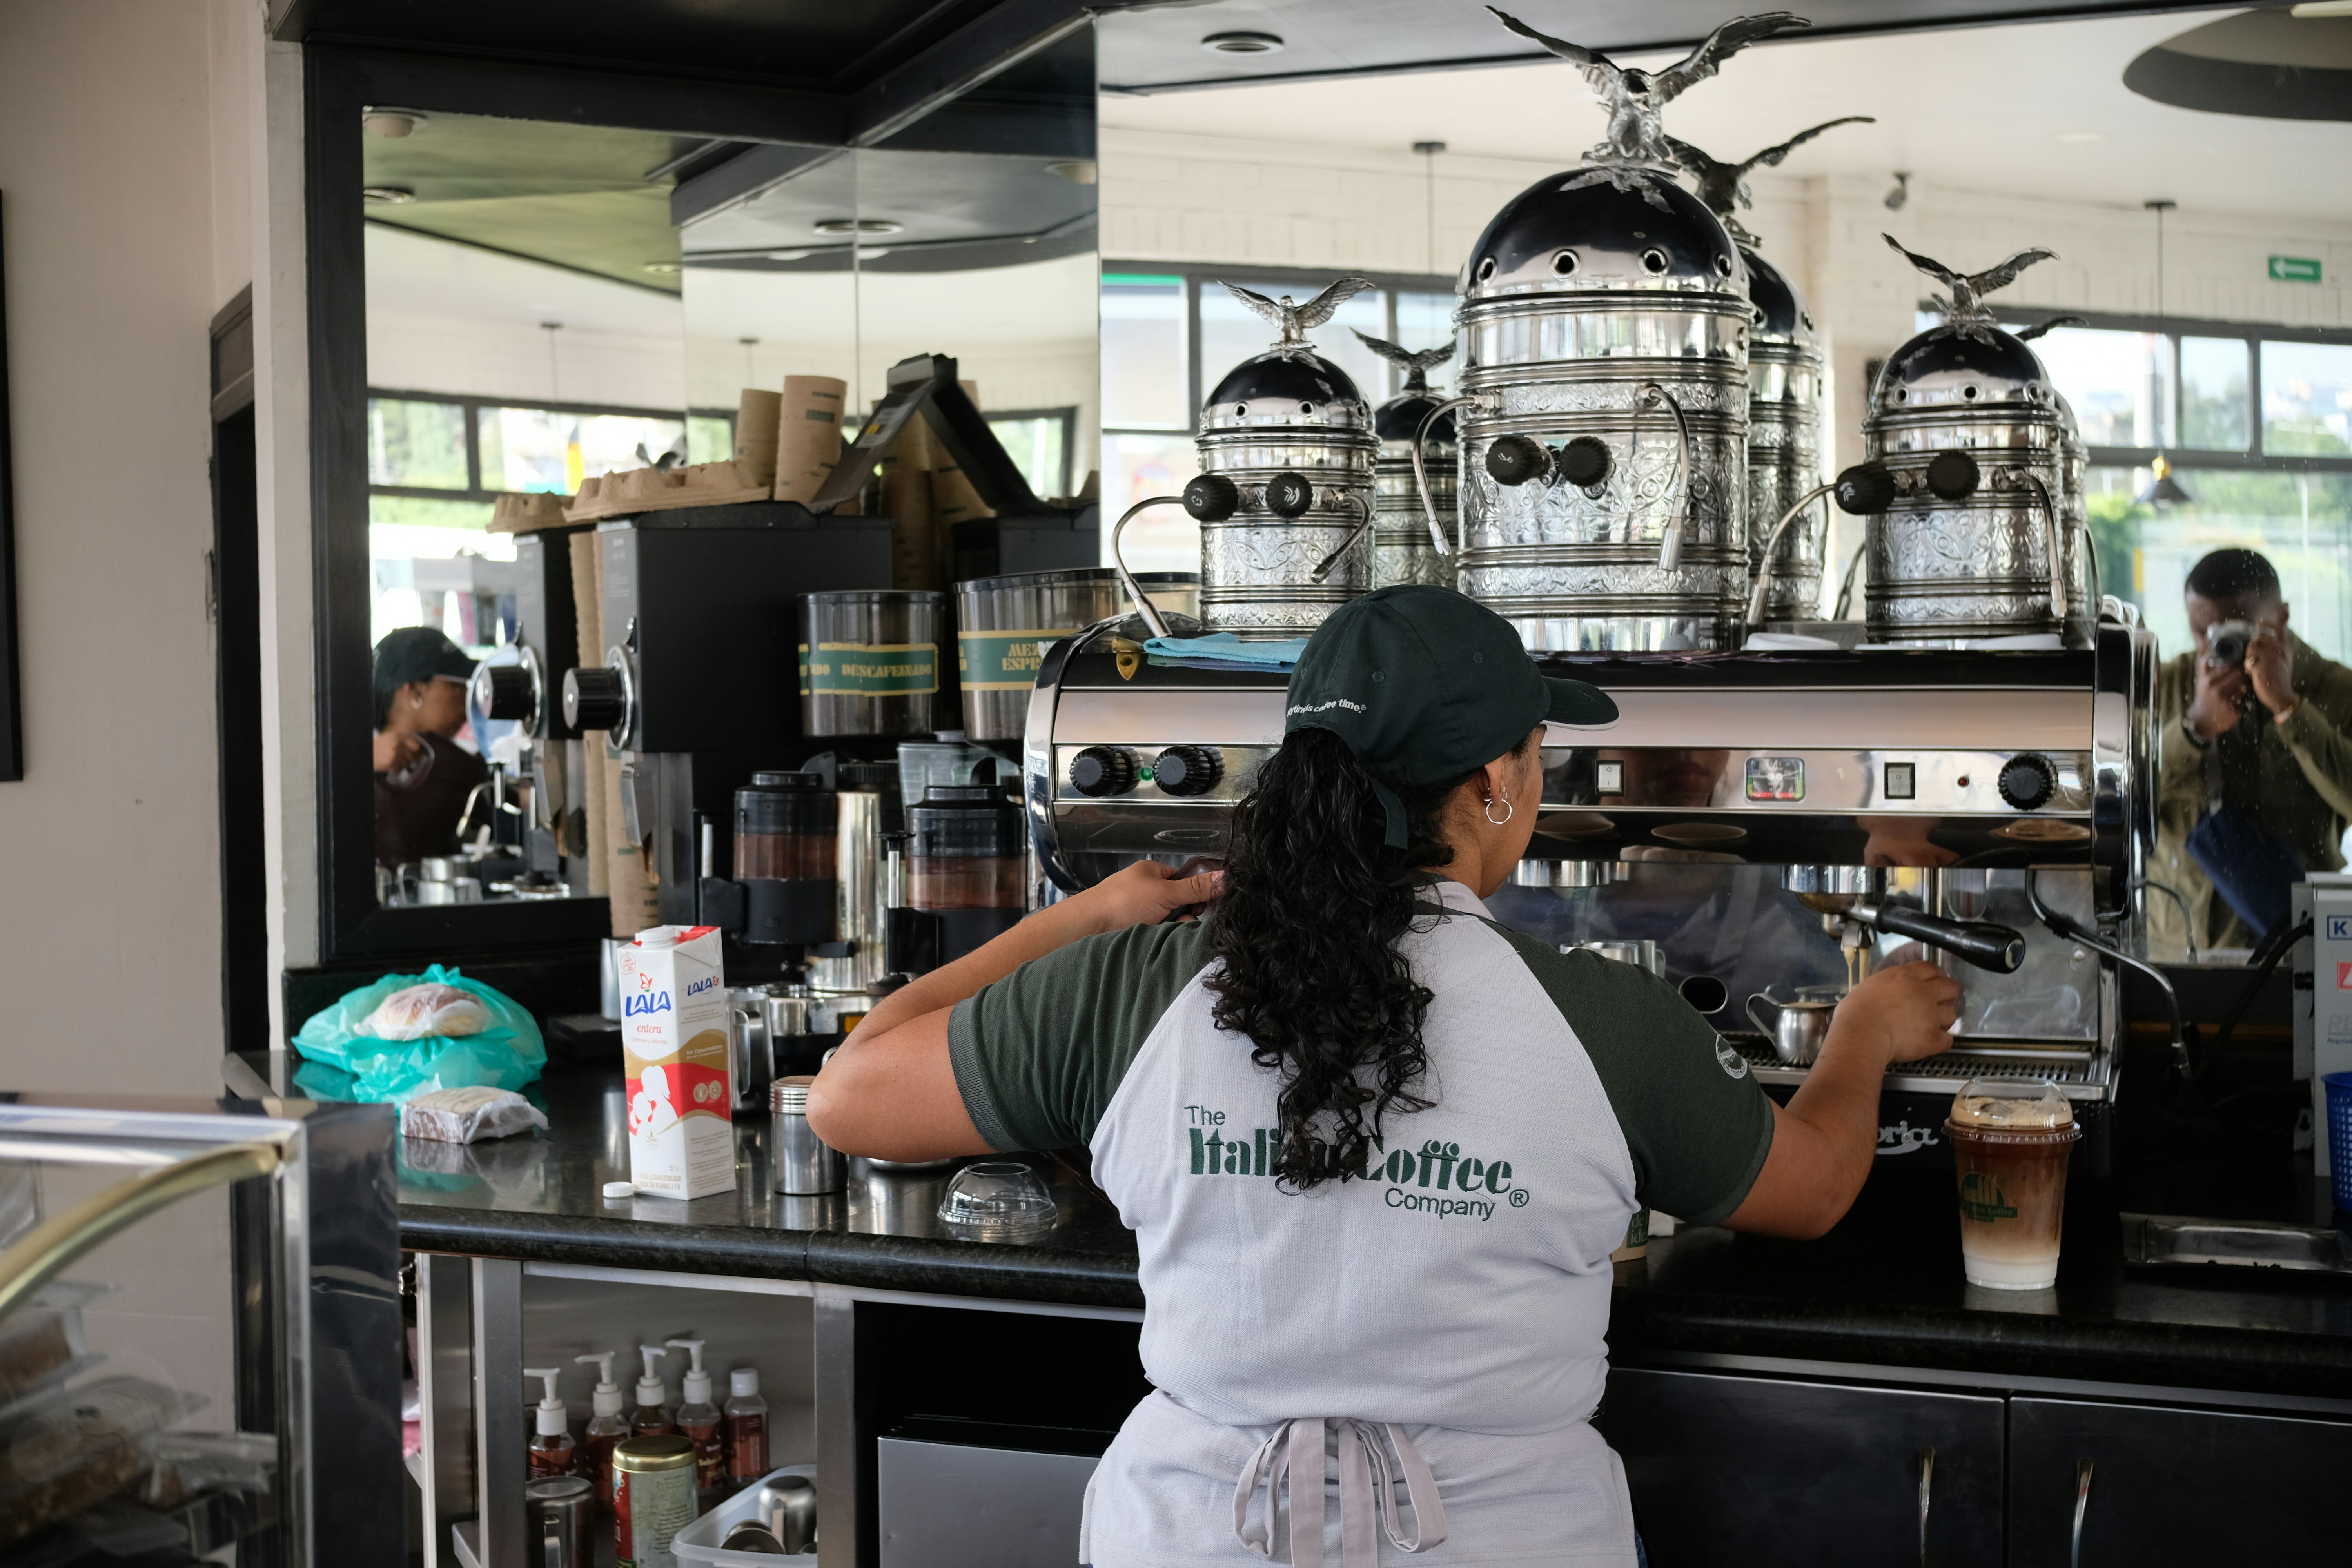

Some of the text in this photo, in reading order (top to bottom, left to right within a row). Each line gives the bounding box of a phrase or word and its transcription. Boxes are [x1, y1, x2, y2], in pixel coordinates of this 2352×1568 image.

[1008, 643, 1047, 657] MEZ
[841, 663, 933, 678] DESCAFEINADO
[1002, 656, 1043, 671] ESPR
[688, 978, 713, 996] LALA
[626, 991, 671, 1017] LALA
[637, 1024, 662, 1034] entera
[1184, 1105, 1225, 1126] The
[1878, 1120, 1939, 1149] oria
[1385, 1188, 1495, 1221] Company
[1630, 1228, 1648, 1244] ide
